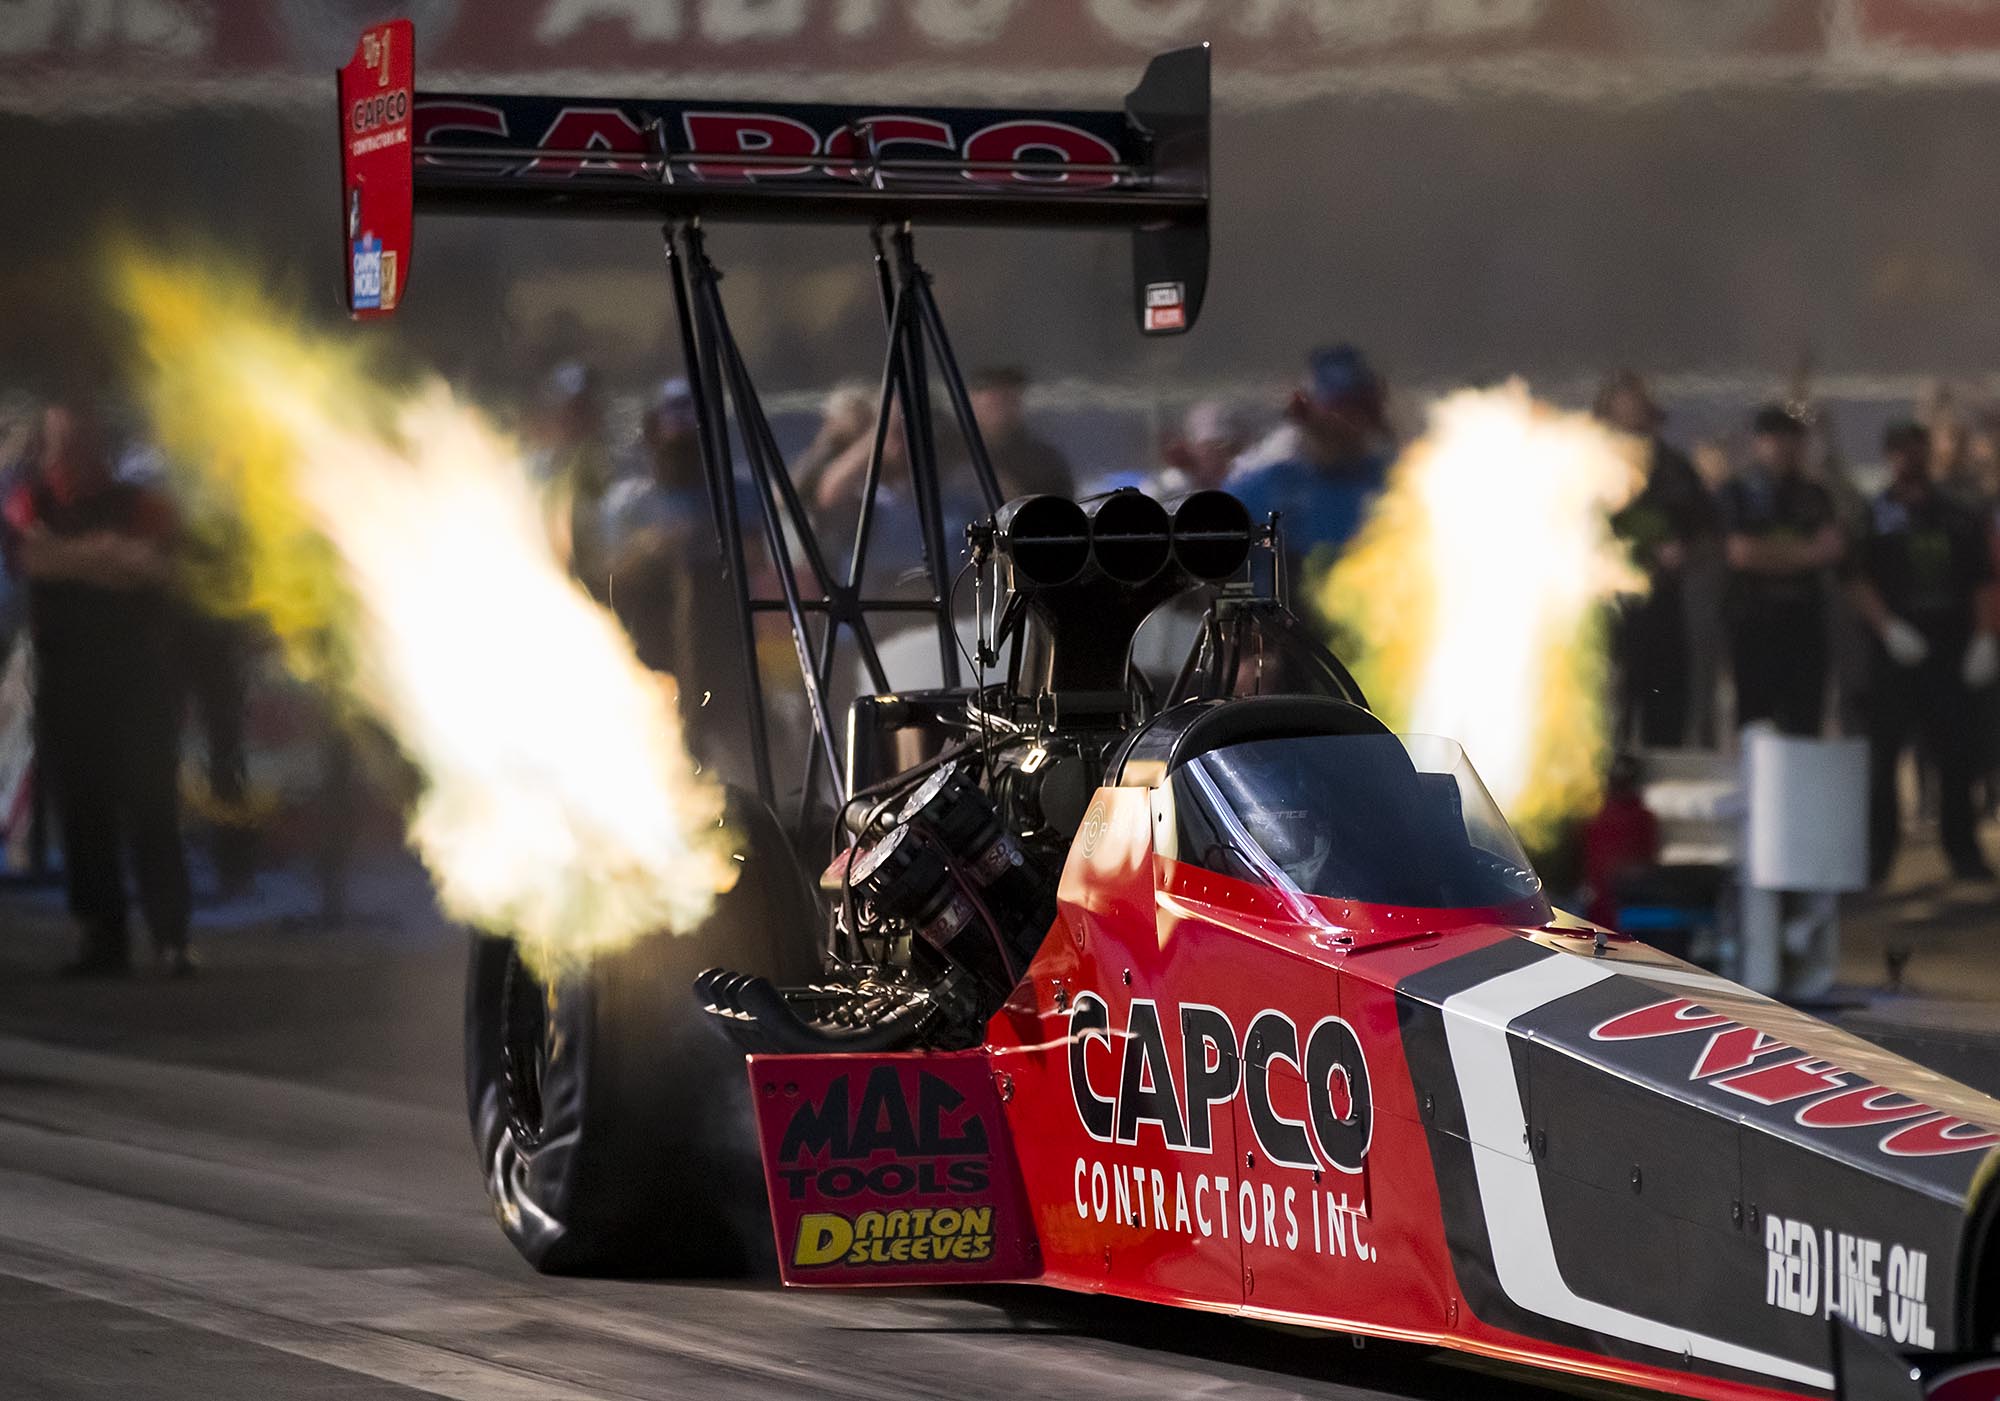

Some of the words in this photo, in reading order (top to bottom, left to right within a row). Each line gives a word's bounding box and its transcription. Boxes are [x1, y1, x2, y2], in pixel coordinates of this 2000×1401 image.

[352, 88, 407, 133] CAPCO
[412, 101, 1121, 190] CAPCO
[778, 1065, 990, 1163] MAC
[1067, 989, 1375, 1174] CAPCO
[778, 1160, 990, 1200] TOOLS
[1074, 1157, 1300, 1251] CONTRACTORS
[1312, 1189, 1377, 1263] INC.
[794, 1206, 993, 1266] DARTON
[848, 1235, 992, 1264] SLEEVES
[1766, 1214, 1819, 1317] RED
[1824, 1228, 1883, 1337] LINE
[1887, 1244, 1936, 1351] OIL
